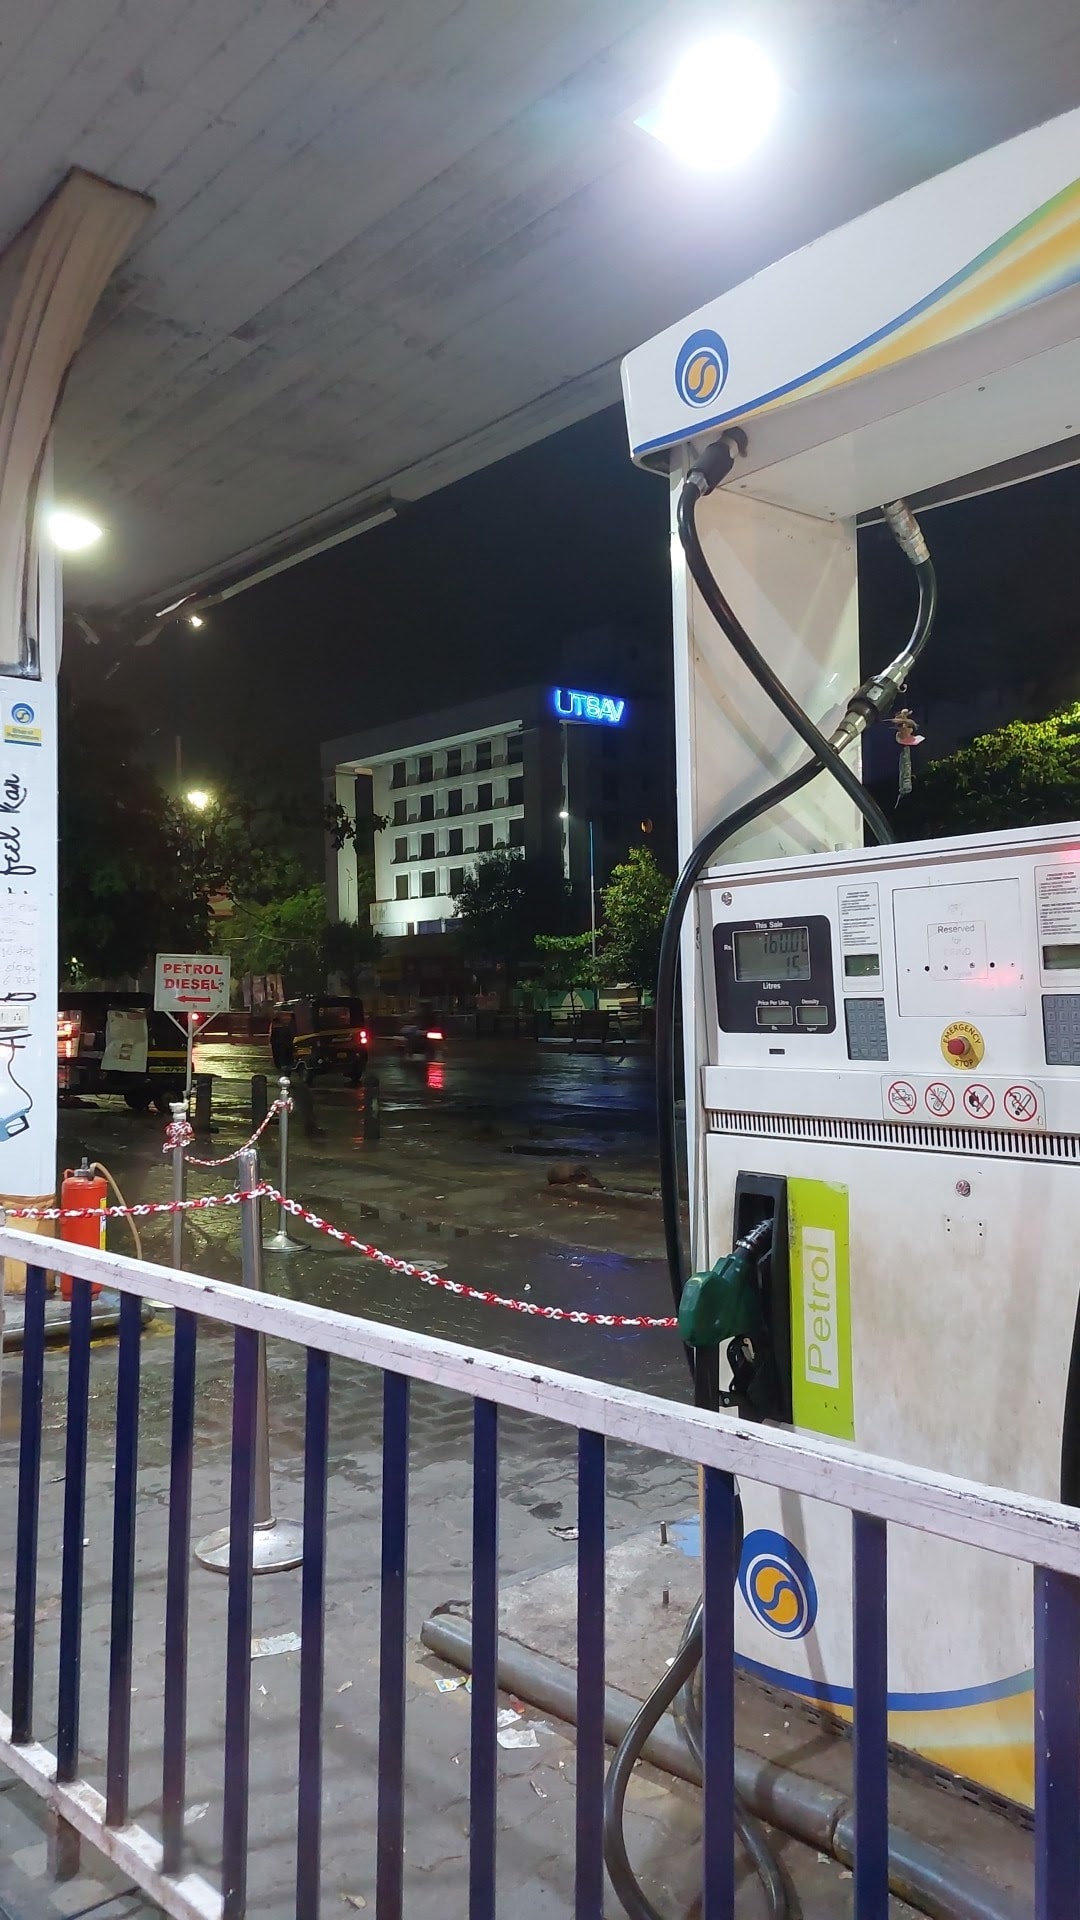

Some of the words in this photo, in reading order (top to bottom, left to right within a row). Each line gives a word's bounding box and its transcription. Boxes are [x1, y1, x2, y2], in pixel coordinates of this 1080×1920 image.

[556, 689, 625, 722] UTSAV
[937, 925, 975, 934] Reserved
[163, 963, 223, 975] PETROL
[164, 978, 220, 990] DIESEL
[763, 982, 781, 990] Litres
[943, 1023, 982, 1044] EMERGENCY
[954, 1059, 974, 1068] STOP
[805, 1244, 832, 1376] Petrol
